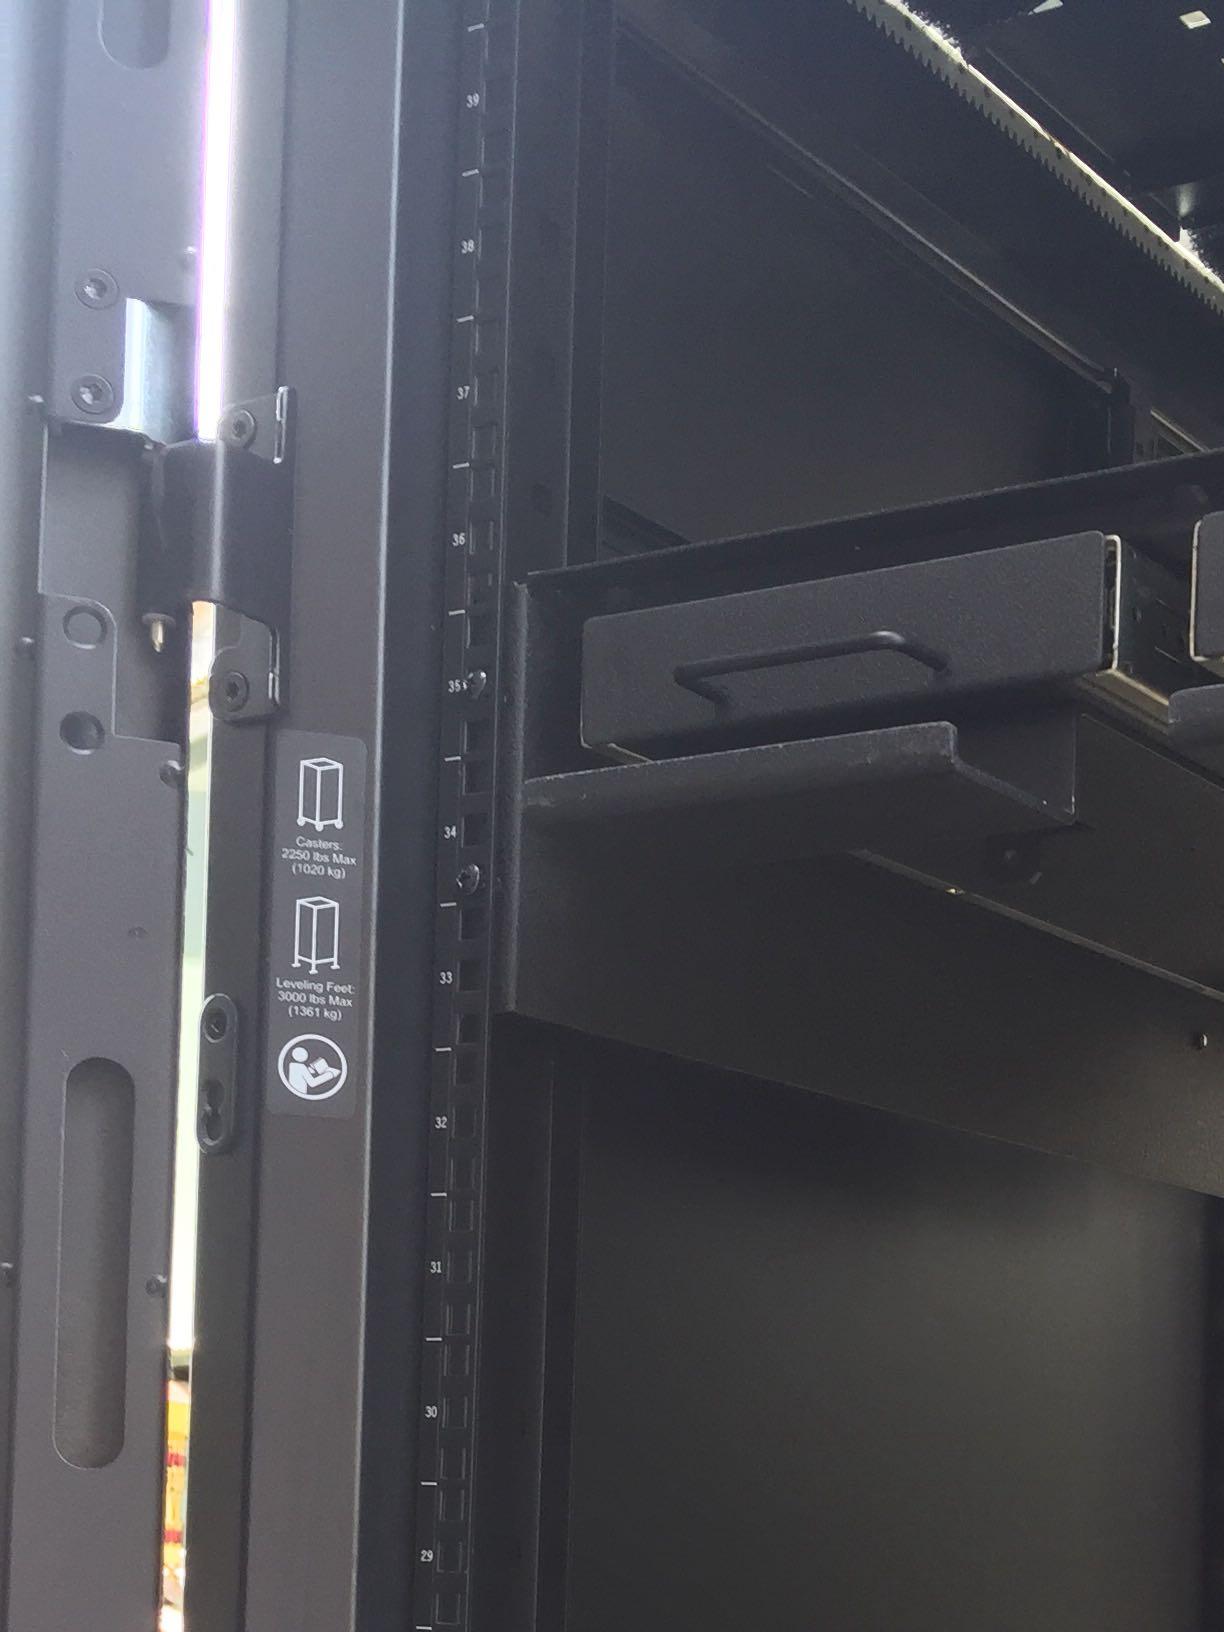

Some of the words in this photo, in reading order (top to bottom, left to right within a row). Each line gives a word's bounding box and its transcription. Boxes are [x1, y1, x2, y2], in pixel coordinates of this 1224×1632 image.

[466, 93, 480, 109] 39
[461, 239, 475, 254] 38
[456, 385, 470, 400] 37
[452, 532, 466, 547] 36
[448, 679, 461, 693] 35
[444, 826, 457, 840] 34
[281, 847, 311, 861] 2250
[313, 851, 330, 863] lbs
[332, 852, 357, 866] Max
[292, 862, 325, 875] (1020
[328, 866, 346, 879] kg)
[276, 977, 324, 994] Leveling
[440, 971, 453, 985] 33
[278, 990, 307, 1003] 3000
[309, 993, 326, 1005] lbs
[329, 995, 353, 1007] Max
[288, 1005, 320, 1018] (1361
[324, 1008, 342, 1022] kg)
[435, 1116, 448, 1129] 32
[430, 1261, 442, 1274] 31
[425, 1405, 438, 1419] 30
[420, 1549, 434, 1563] 29
